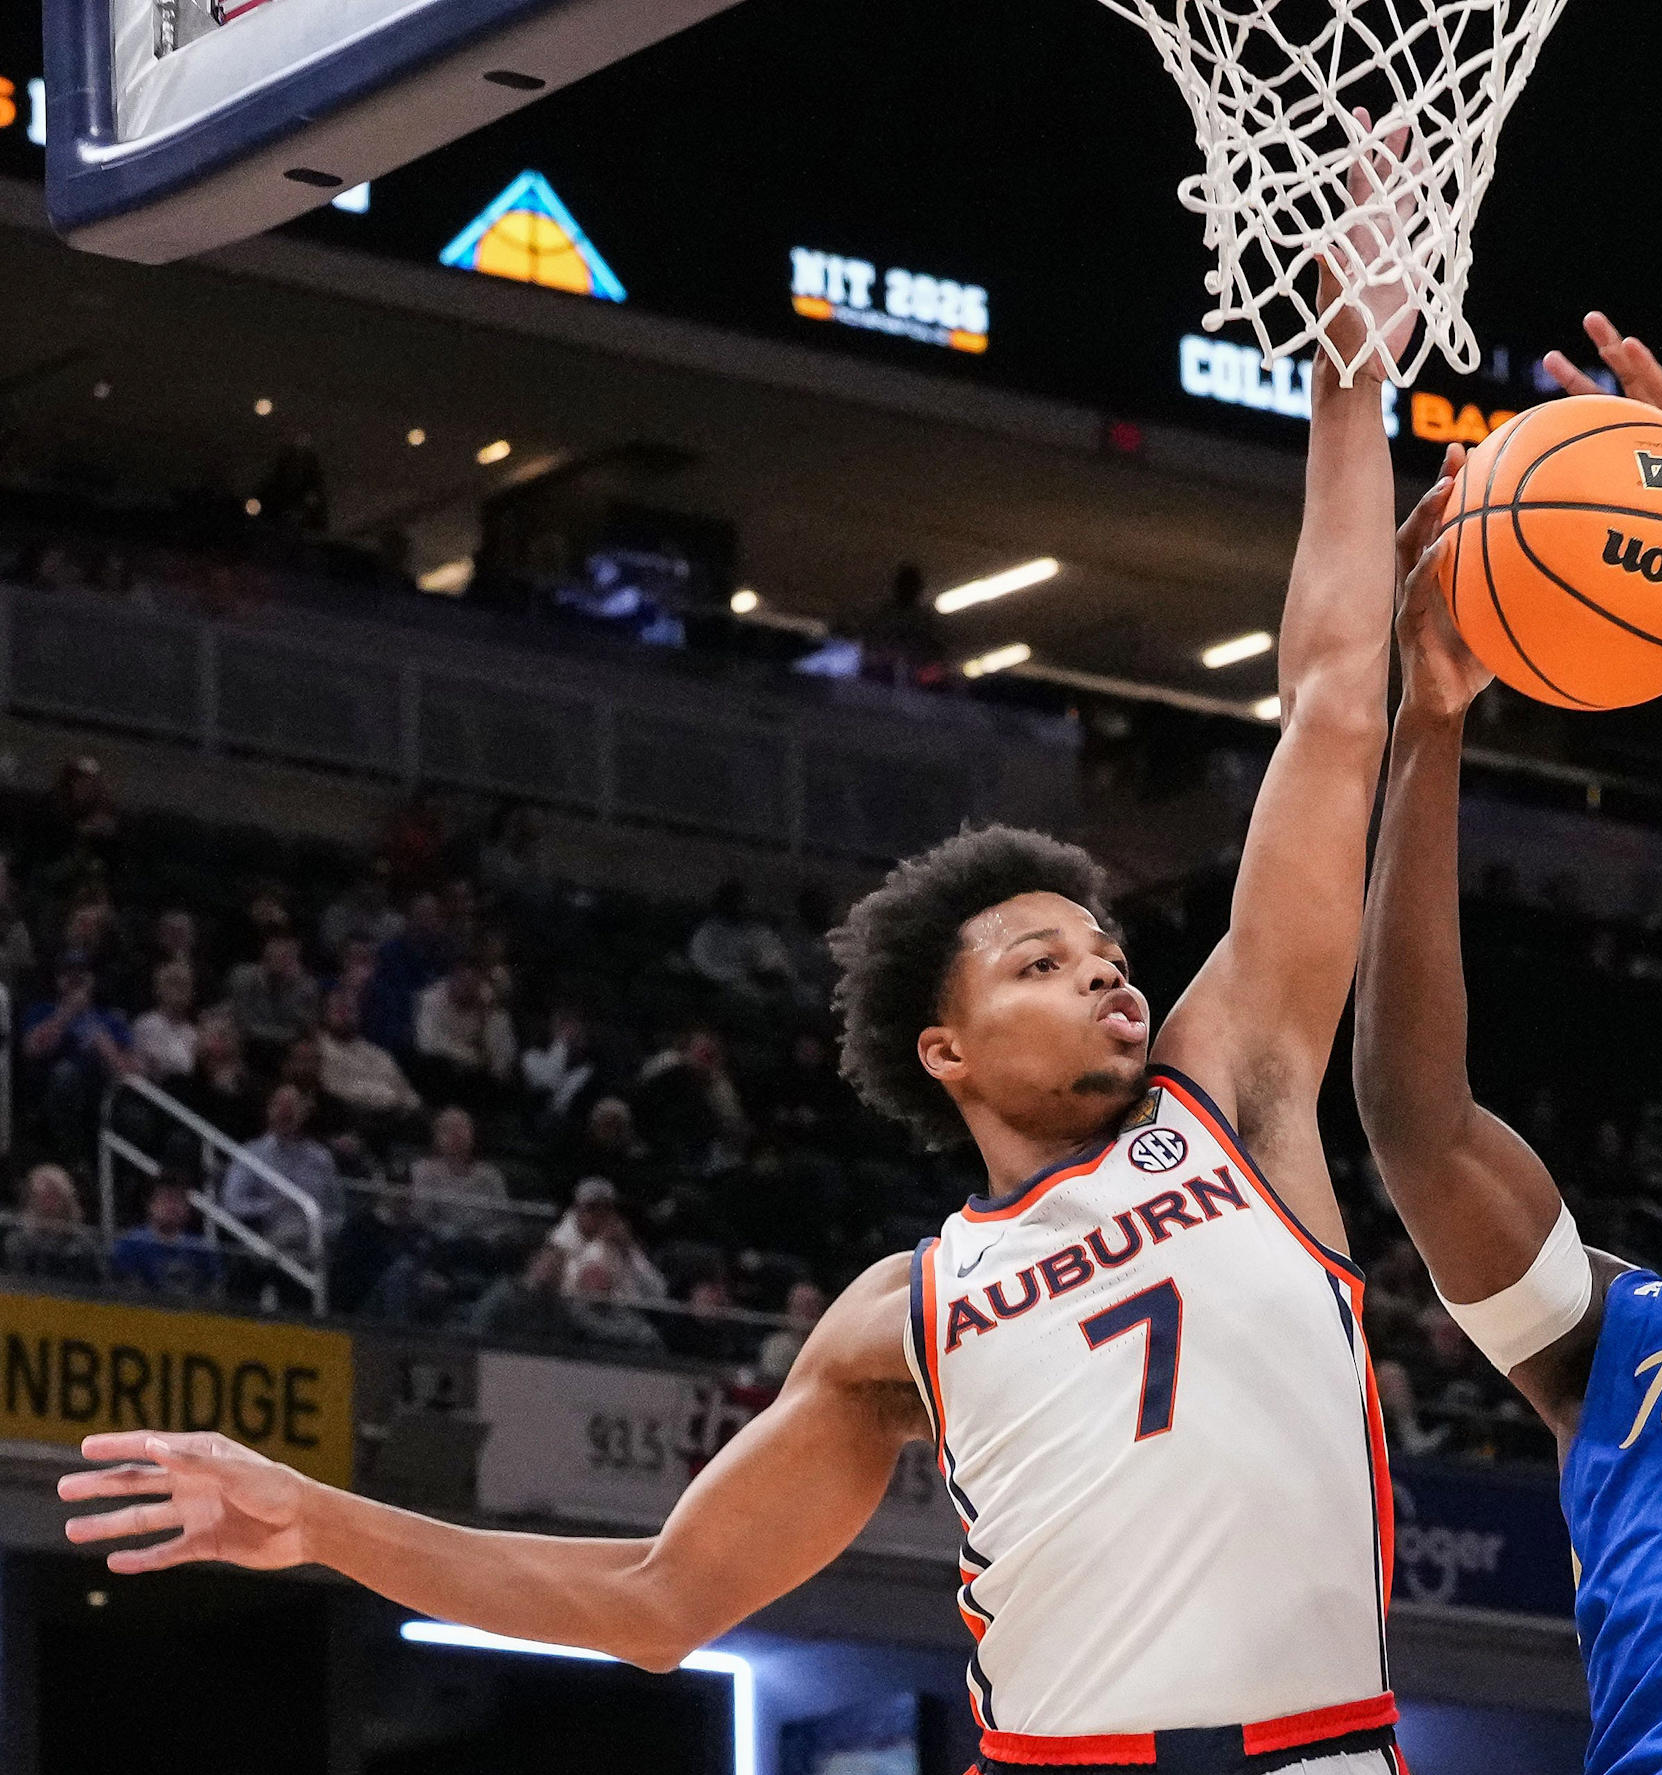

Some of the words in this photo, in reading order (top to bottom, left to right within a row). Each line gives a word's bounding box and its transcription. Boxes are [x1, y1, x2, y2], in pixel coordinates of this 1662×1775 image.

[1179, 333, 1399, 438] COLL
[1131, 1129, 1185, 1171] SEC
[945, 1165, 1250, 1353] AUBURN
[3, 1333, 319, 1449] NBRIDGE
[1078, 1278, 1183, 1442] 7
[1394, 1525, 1505, 1606] oger
